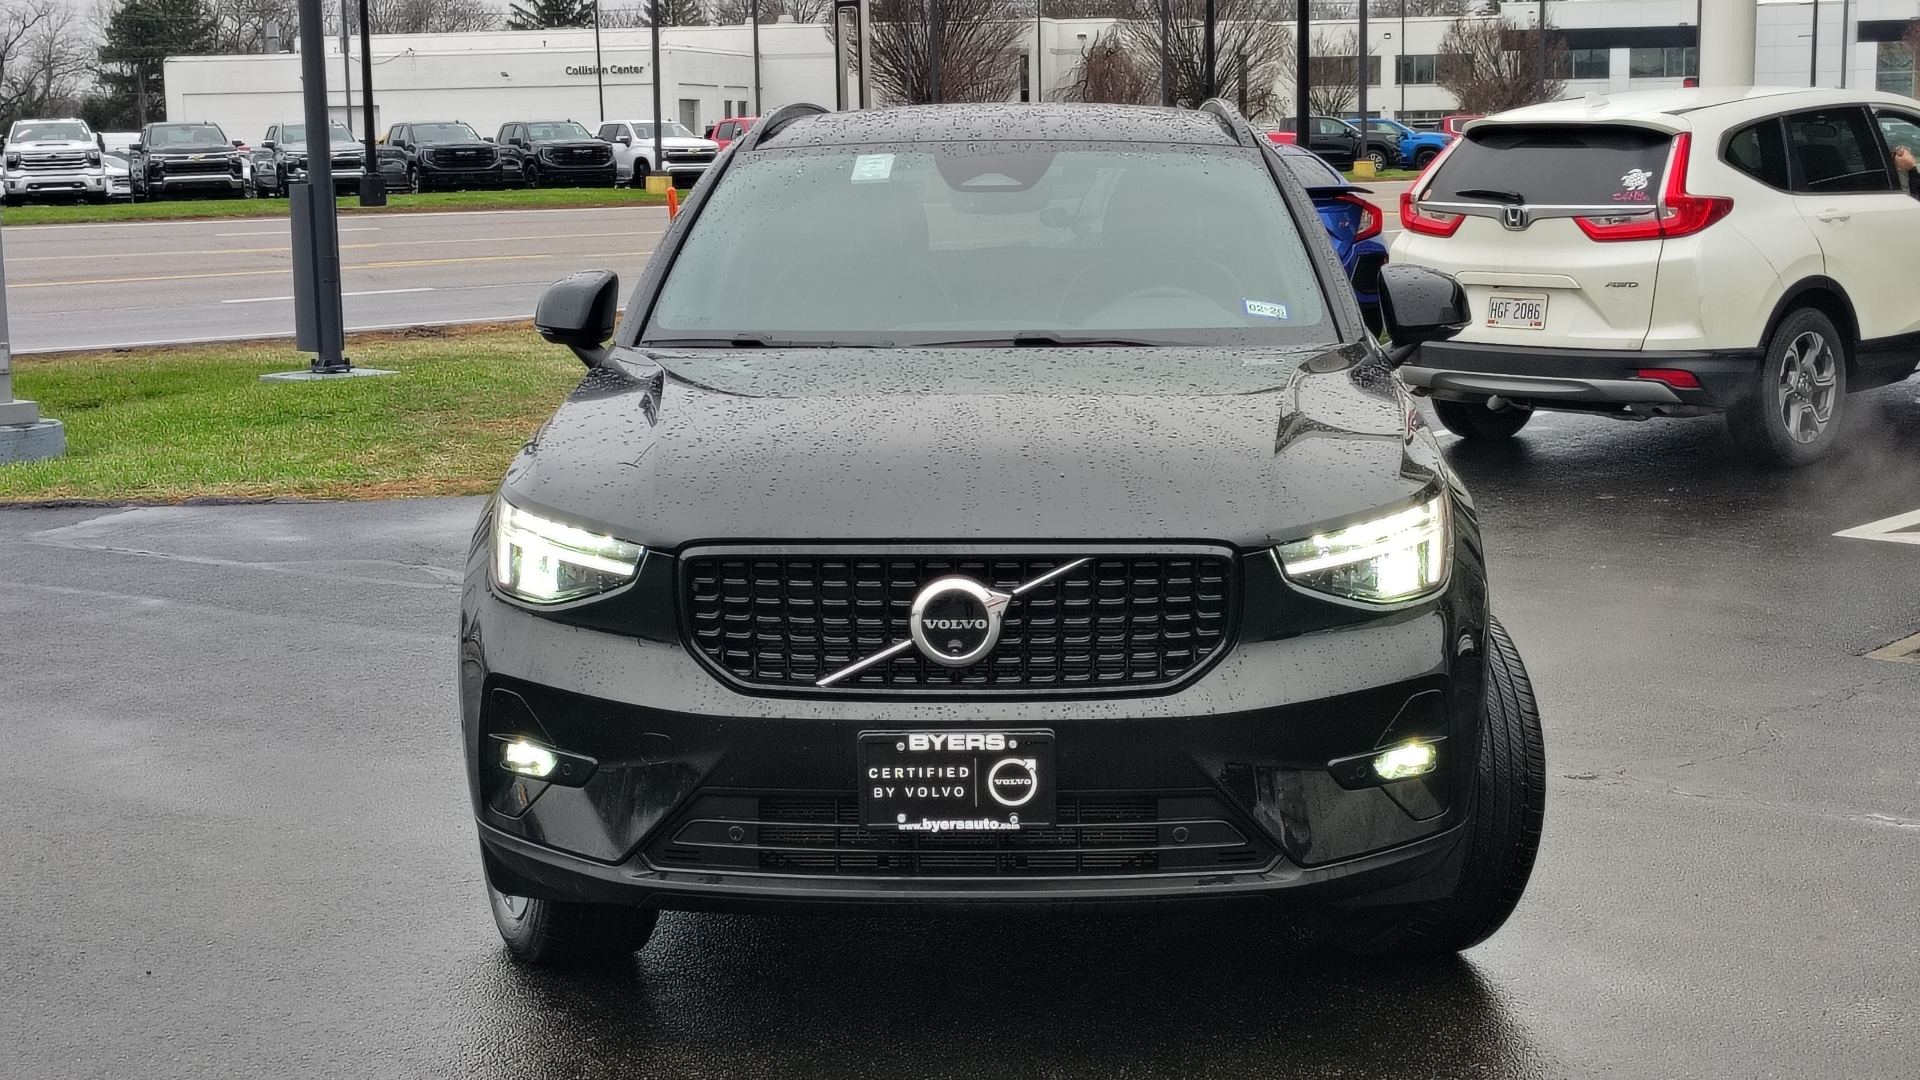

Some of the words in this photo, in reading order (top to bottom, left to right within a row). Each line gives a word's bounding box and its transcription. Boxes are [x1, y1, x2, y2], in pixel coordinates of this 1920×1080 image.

[610, 64, 644, 74] Center
[1490, 301, 1511, 319] HGF
[1513, 302, 1541, 320] 2086
[922, 619, 988, 630] VOLVO
[908, 733, 1006, 751] BYERS
[868, 766, 970, 779] CERTIFIED
[993, 778, 1032, 786] VOLVO
[873, 786, 895, 798] BY
[904, 786, 965, 798] VOLVO
[898, 818, 1020, 832] www.byersauto.com
